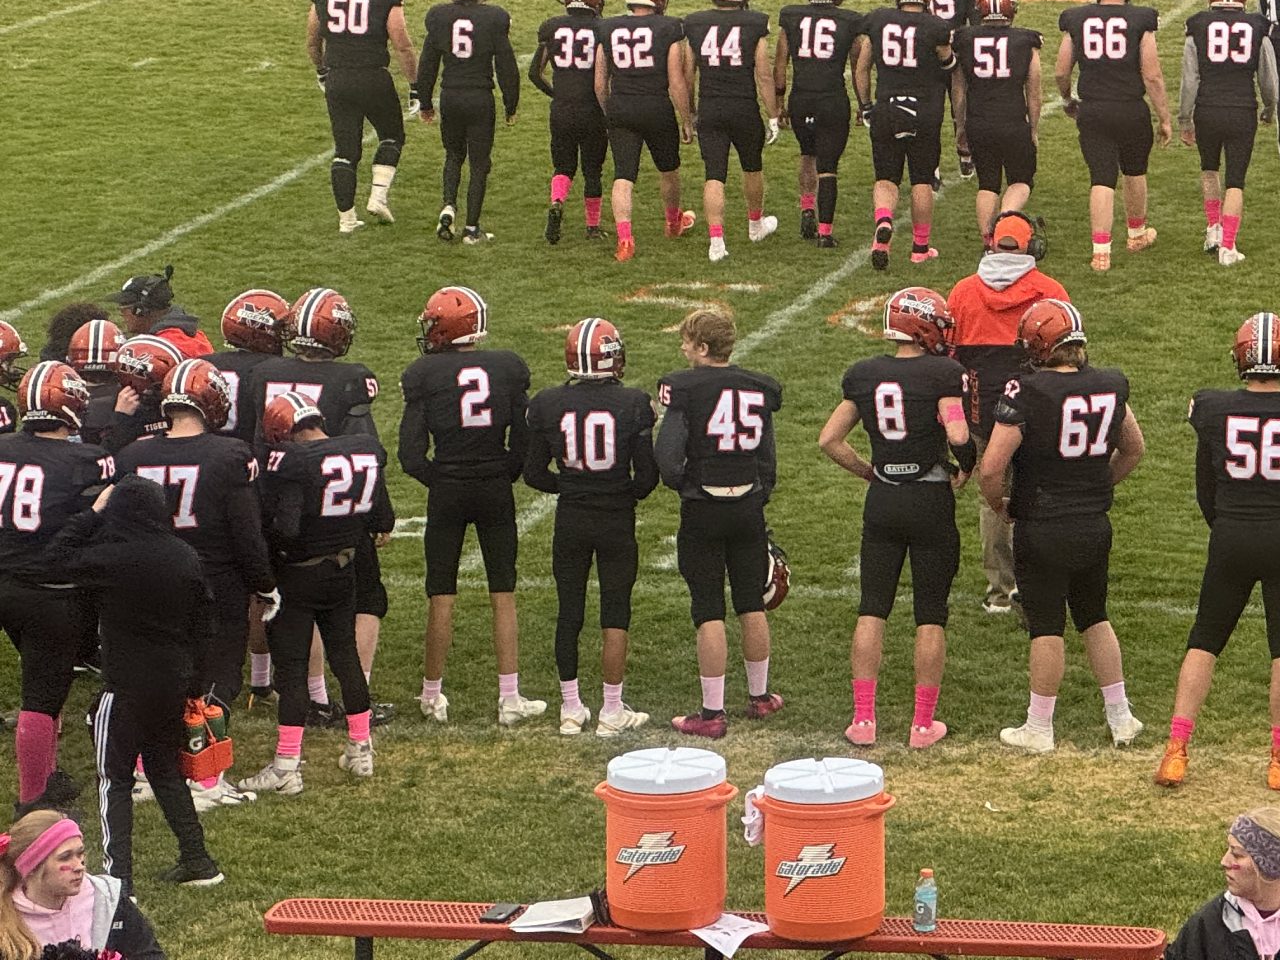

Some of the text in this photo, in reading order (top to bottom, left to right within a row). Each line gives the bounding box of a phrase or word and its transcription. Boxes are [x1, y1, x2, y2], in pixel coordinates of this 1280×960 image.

[452, 18, 474, 59] 6
[554, 27, 595, 69] 33
[610, 27, 654, 69] 62
[700, 25, 743, 66] 44
[798, 16, 837, 59] 16
[882, 23, 917, 68] 61
[973, 37, 1011, 78] 51
[1082, 17, 1127, 59] 66
[1207, 21, 1253, 63] 83
[456, 366, 493, 428] 2
[875, 381, 907, 441] 8
[560, 410, 616, 471] 10
[706, 388, 765, 452] 45
[1058, 391, 1117, 459] 67
[97, 455, 116, 479] 78
[267, 451, 286, 472] 27
[320, 453, 379, 517] 27
[189, 736, 203, 751] G
[617, 847, 681, 864] Gatorade
[778, 859, 841, 876] Gatorade
